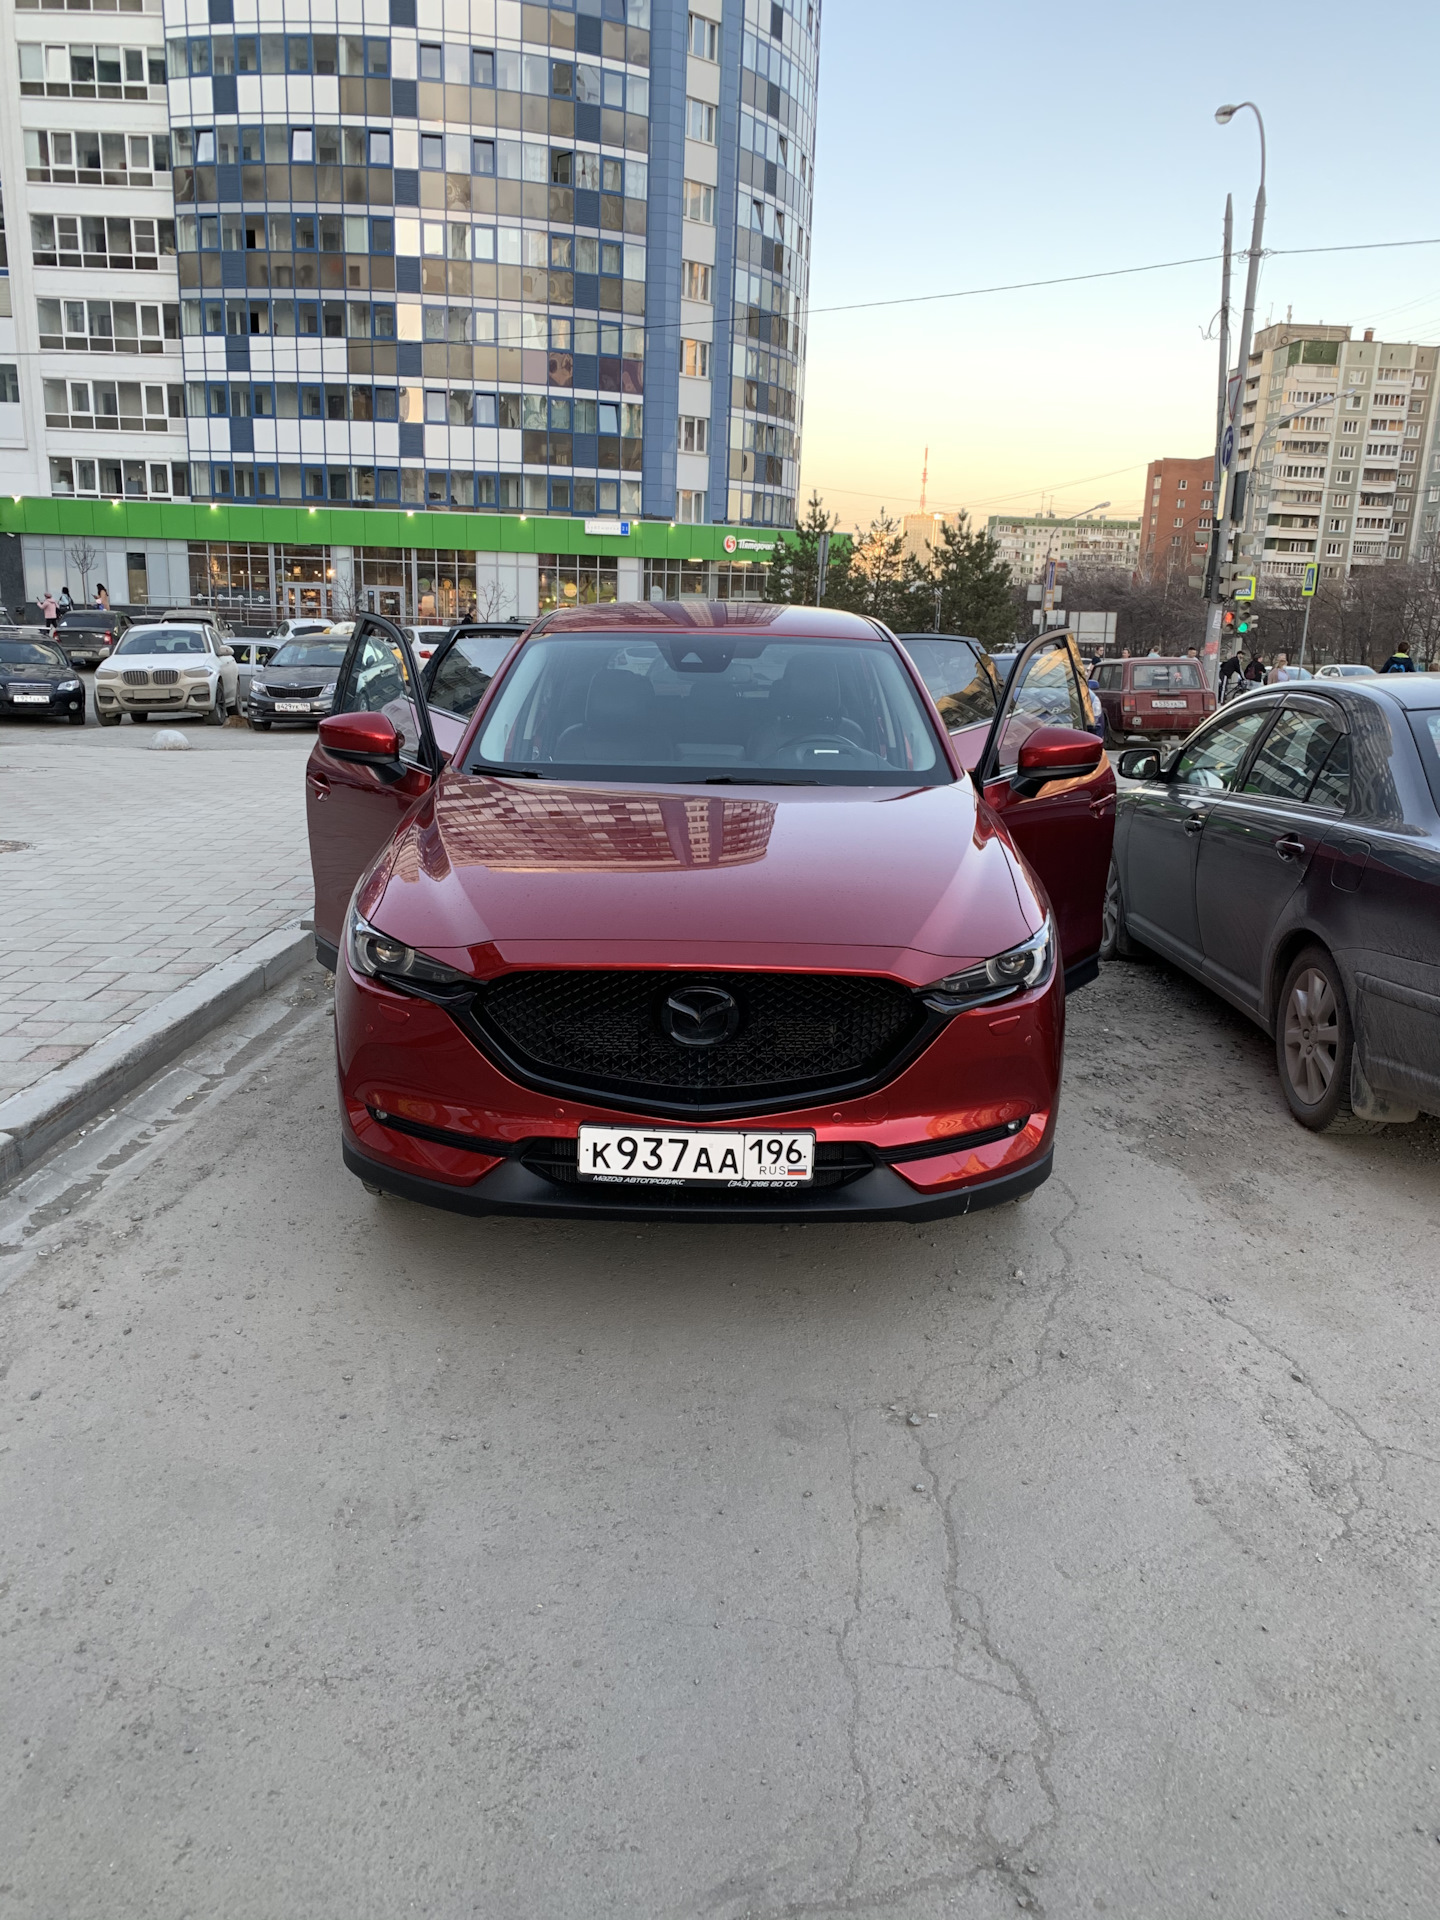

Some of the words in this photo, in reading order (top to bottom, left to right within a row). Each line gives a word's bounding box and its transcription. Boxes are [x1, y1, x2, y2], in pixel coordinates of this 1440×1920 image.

[738, 539, 776, 552] Пятерочк
[748, 1138, 803, 1165] 196
[759, 1166, 786, 1175] RUS
[624, 1177, 686, 1186] АВТОПРОДИКС
[728, 1180, 751, 1188] (343)
